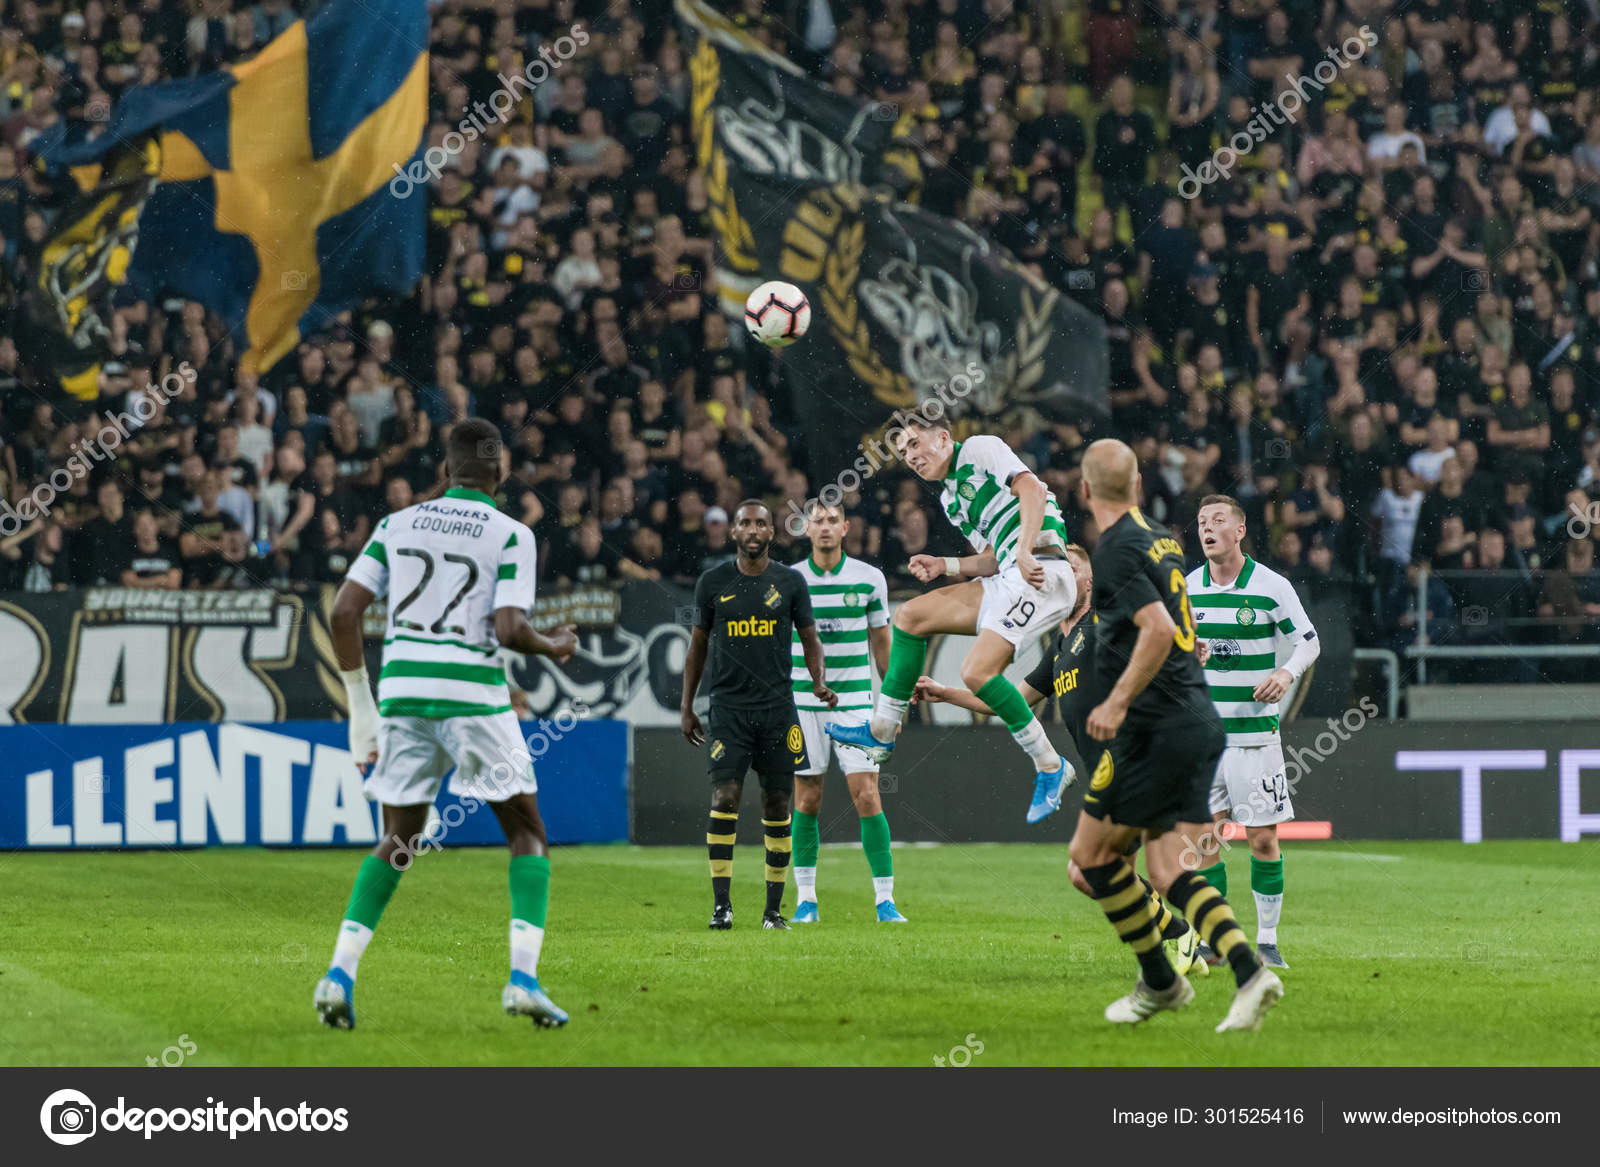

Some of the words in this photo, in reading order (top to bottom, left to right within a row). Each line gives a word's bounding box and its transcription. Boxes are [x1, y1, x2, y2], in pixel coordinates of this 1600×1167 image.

[416, 503, 491, 521] MAGNERS
[412, 517, 484, 538] EDOUARD
[393, 548, 479, 636] 22
[1006, 595, 1036, 628] 19
[727, 616, 777, 637] notar
[1262, 772, 1287, 803] 42
